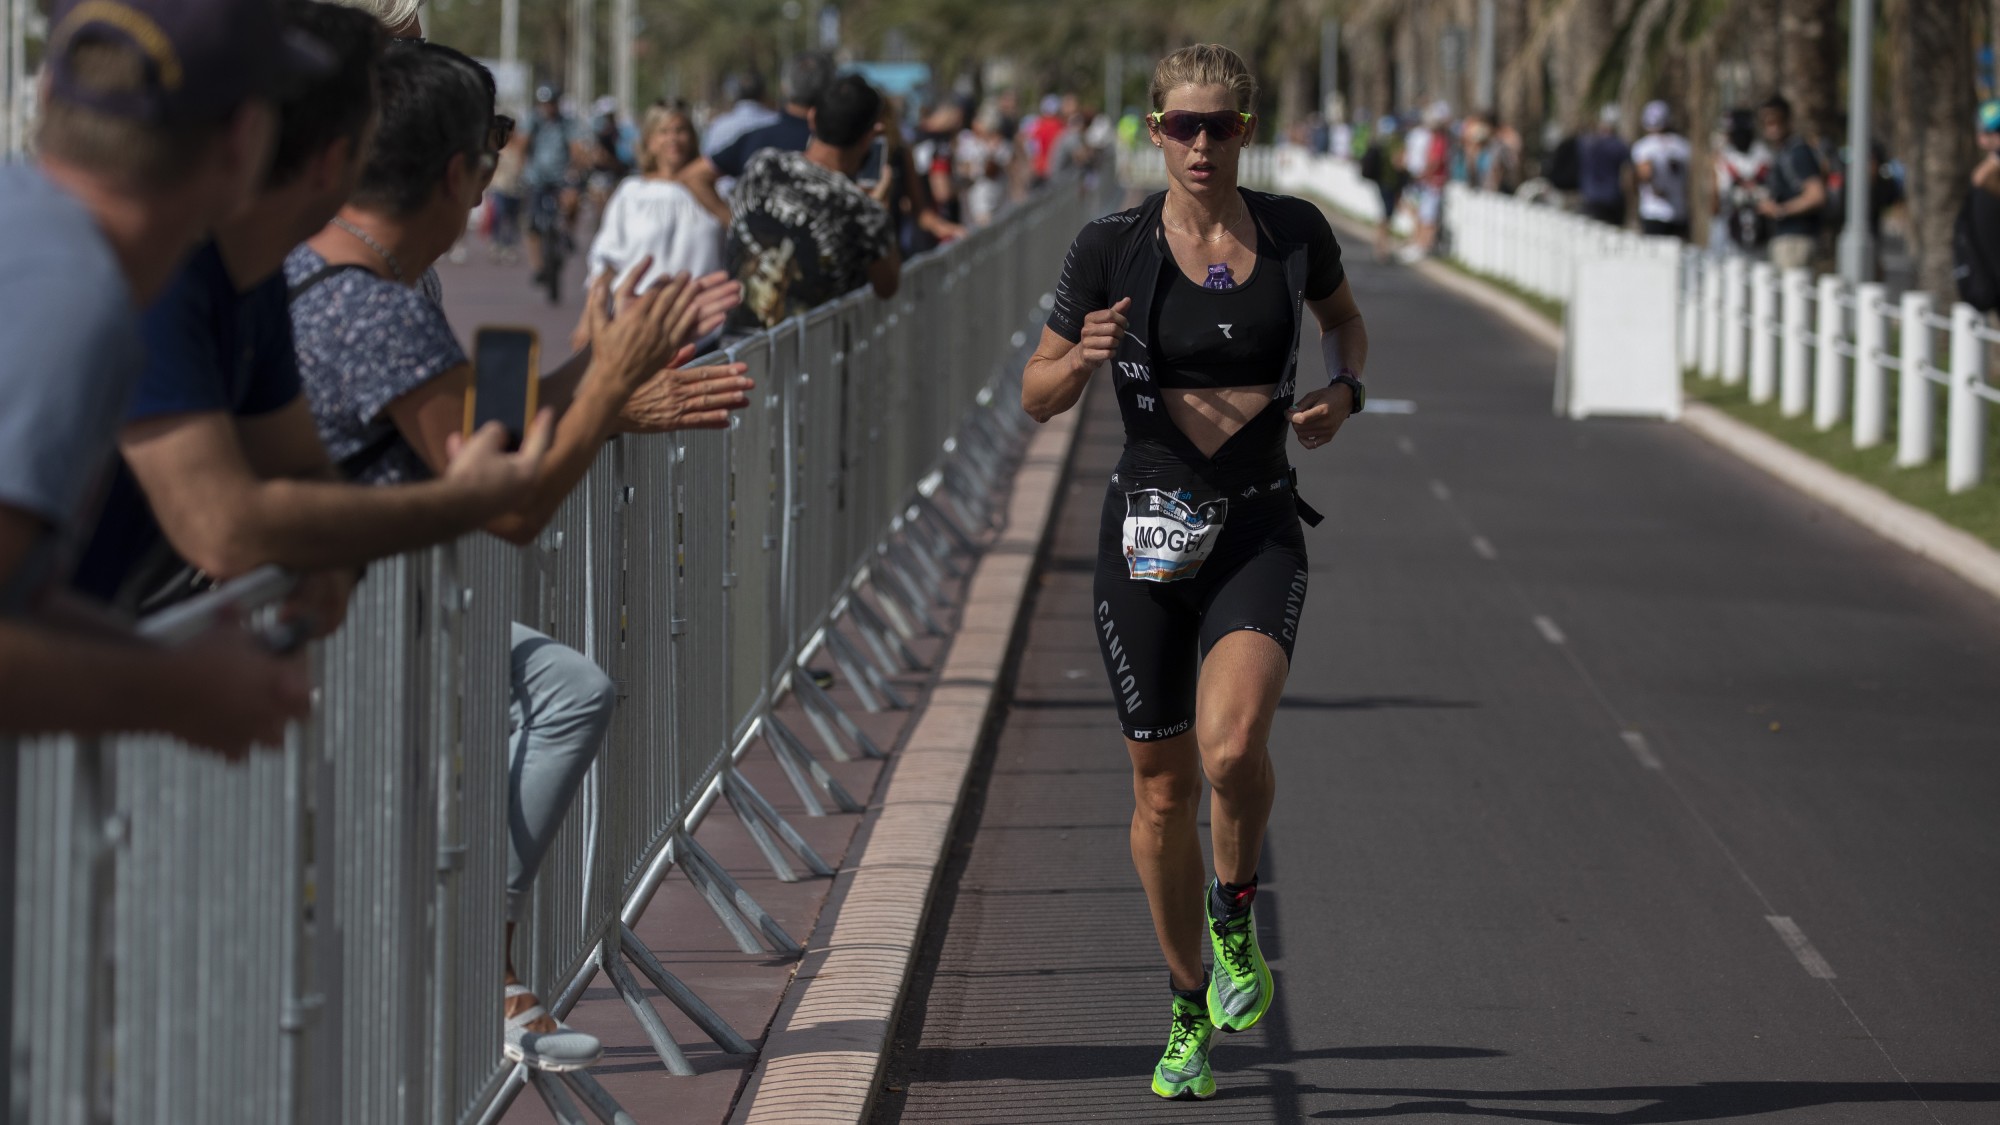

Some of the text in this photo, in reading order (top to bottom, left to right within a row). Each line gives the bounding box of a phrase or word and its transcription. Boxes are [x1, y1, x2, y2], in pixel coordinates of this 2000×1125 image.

[1136, 393, 1155, 412] DT
[1282, 568, 1308, 641] CANYON
[1098, 600, 1143, 714] CANYON
[1134, 719, 1189, 739] DT SWISS
